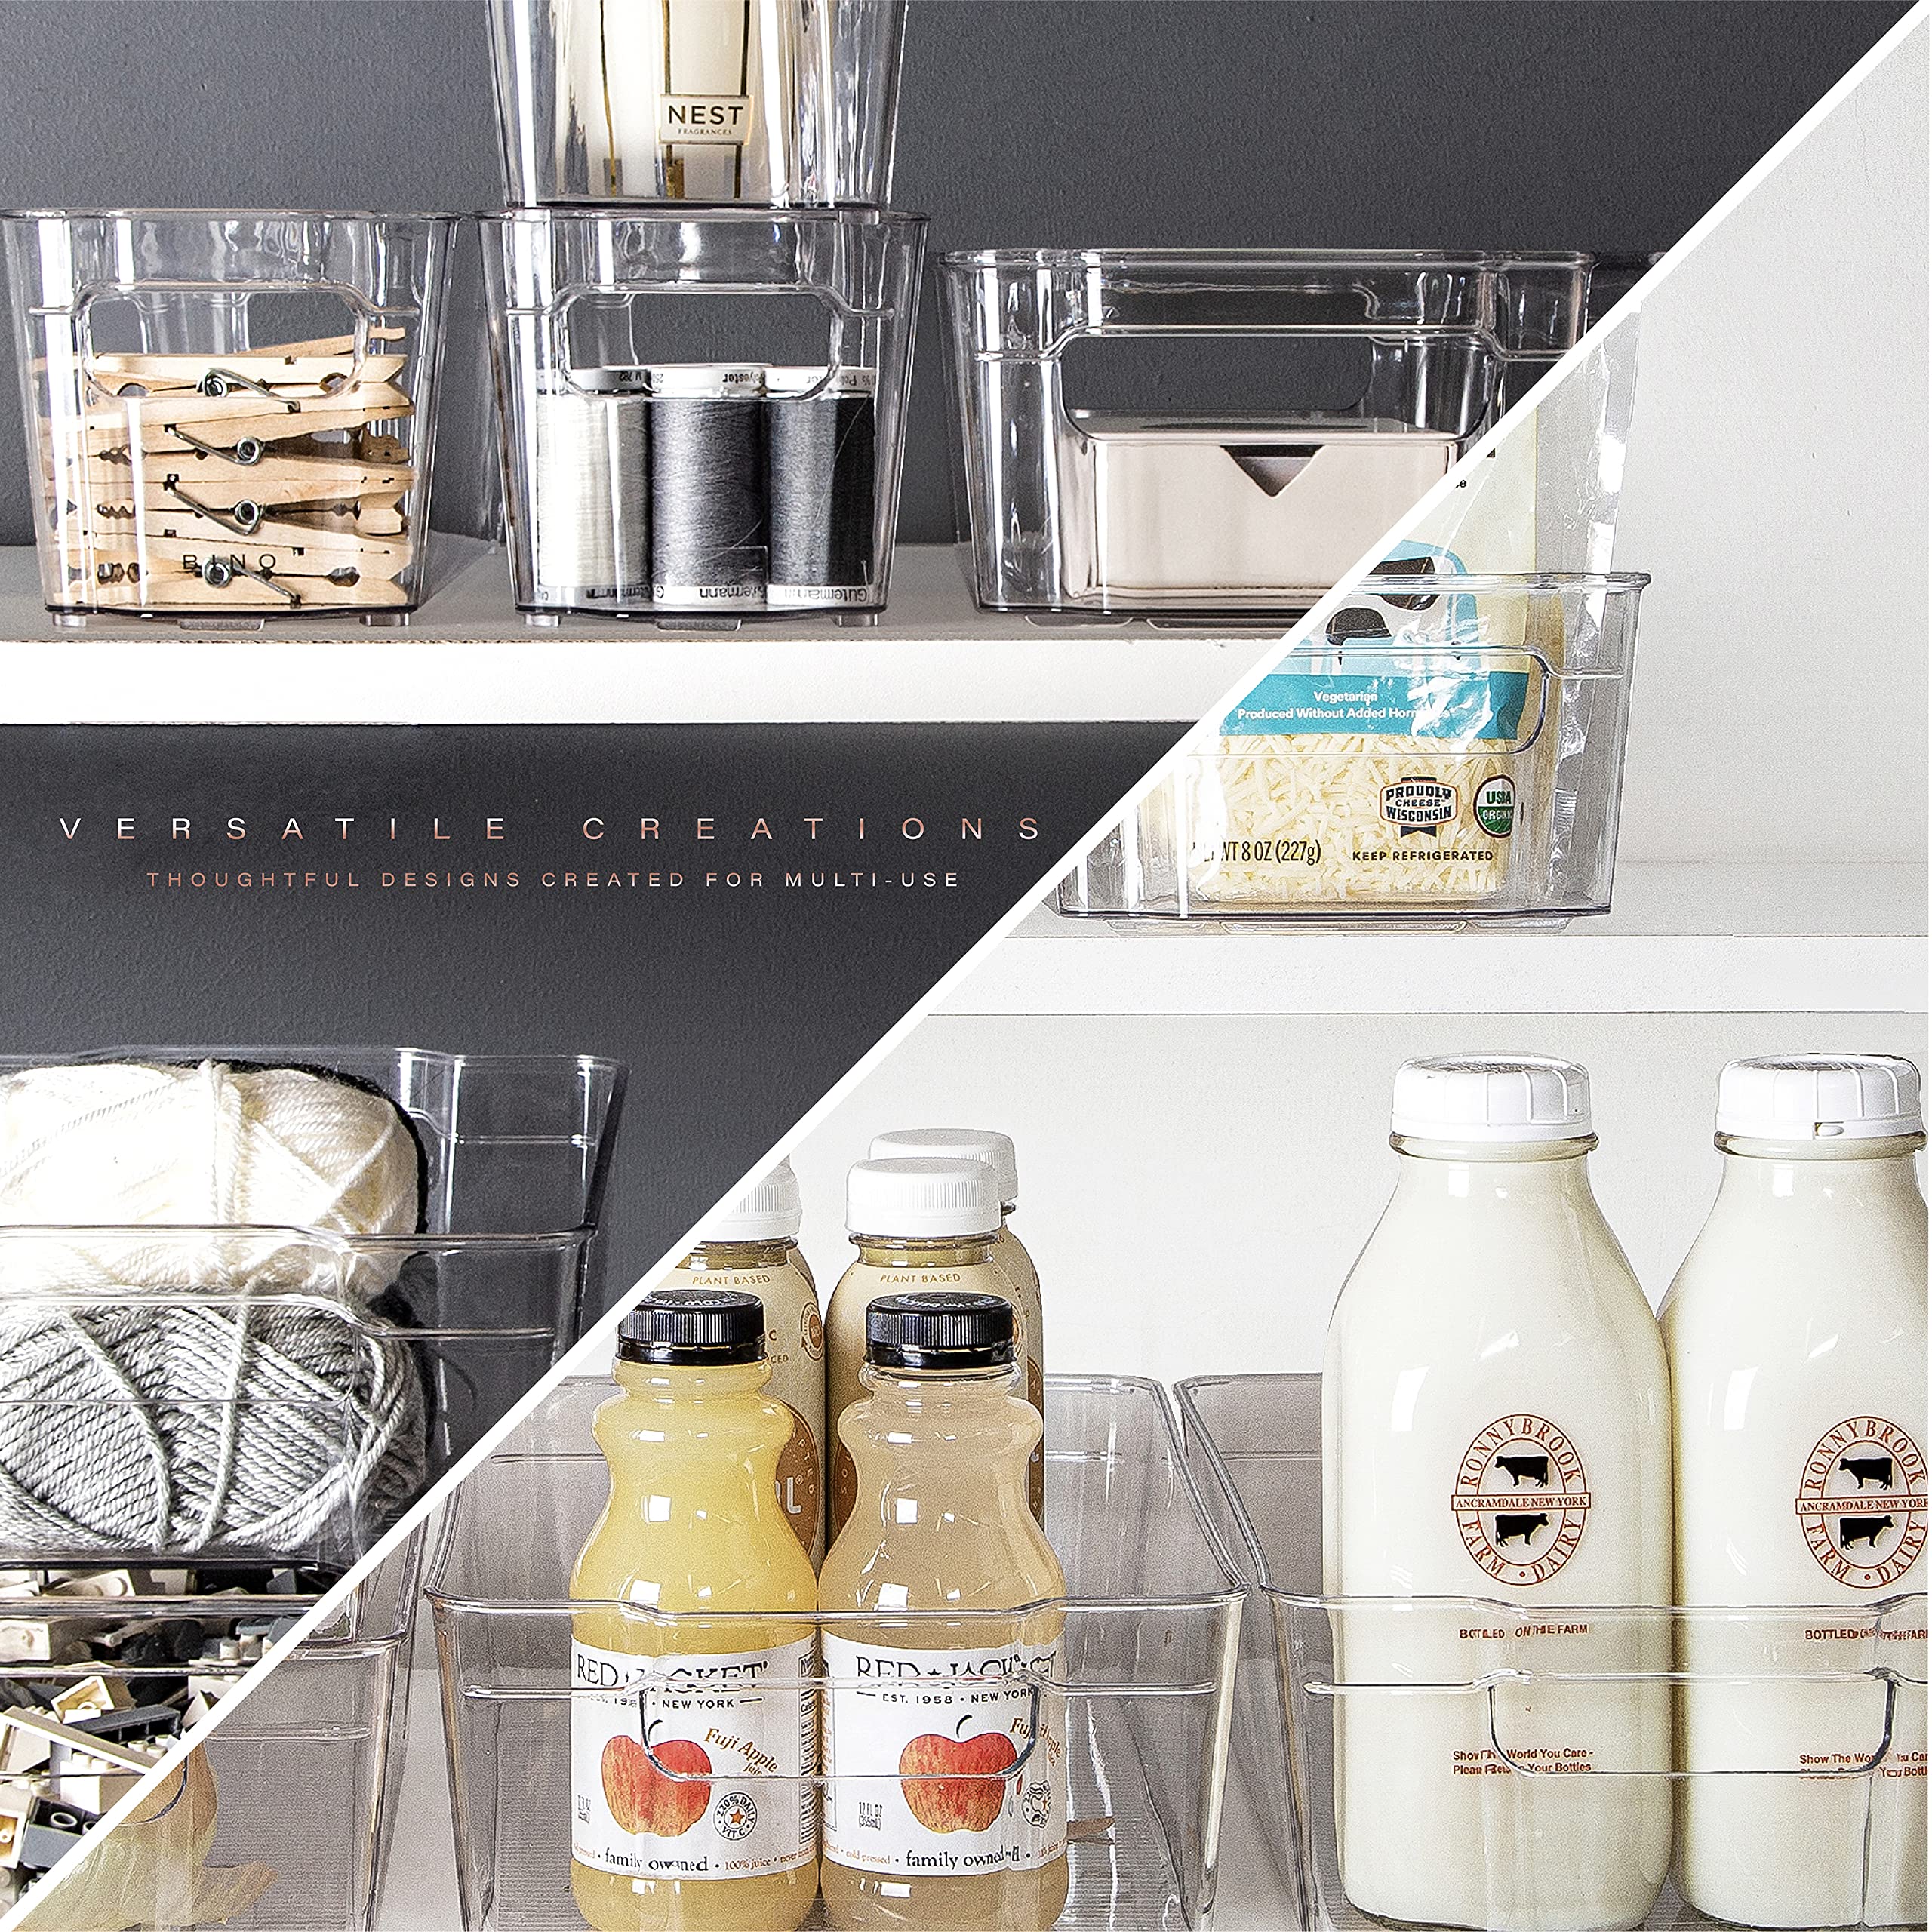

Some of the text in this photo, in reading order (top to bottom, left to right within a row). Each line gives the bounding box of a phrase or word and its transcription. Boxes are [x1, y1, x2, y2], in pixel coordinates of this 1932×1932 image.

[669, 106, 743, 125] NEST
[183, 554, 276, 569] BINO
[1313, 691, 1378, 704] Vegetarian
[1238, 708, 1294, 720] Produced
[1296, 708, 1345, 718] Without
[1346, 708, 1386, 718] Added
[1386, 785, 1452, 801] PROUDLY
[1386, 805, 1452, 822] WISCONSIN
[1241, 841, 1251, 861] 8
[1254, 841, 1272, 861] OZ
[1275, 839, 1321, 866] (227g)
[1352, 851, 1494, 861] KEEP REFRIGERATED
[692, 1274, 771, 1285] PLANT BASED
[879, 1272, 961, 1284] PLANT BASED
[1460, 1418, 1582, 1488] RONNYBROOK
[1804, 1420, 1926, 1491] RONNYBROOK
[1456, 1496, 1587, 1508] ANCRAMDALE NEW YORK
[1800, 1500, 1874, 1512] ANCRAMDALE
[1875, 1500, 1900, 1510] NEW
[1462, 1518, 1506, 1577] FARM
[1531, 1518, 1582, 1583] DAIRY
[1807, 1522, 1851, 1580] FARM
[1875, 1520, 1926, 1585] DAIRY
[1515, 1626, 1531, 1638] ON
[1557, 1624, 1588, 1635] FARM
[577, 1654, 619, 1687] RED
[662, 1700, 692, 1709] NEW
[697, 1699, 734, 1709] YORK
[883, 1693, 909, 1703] EST.
[916, 1695, 952, 1704] 1958
[971, 1692, 999, 1703] NEW
[703, 1727, 740, 1750] Fuji
[737, 1741, 779, 1773] Apple
[1506, 1749, 1538, 1759] World
[1540, 1749, 1560, 1758] You
[1563, 1748, 1587, 1758] Care
[1799, 1755, 1829, 1764] Show
[1832, 1754, 1851, 1764] The
[1555, 1762, 1592, 1772] Bottles
[1904, 1766, 1928, 1776] Bottl
[740, 1796, 755, 1823] DAILY
[605, 1847, 643, 1873] family
[906, 1850, 958, 1871] family
